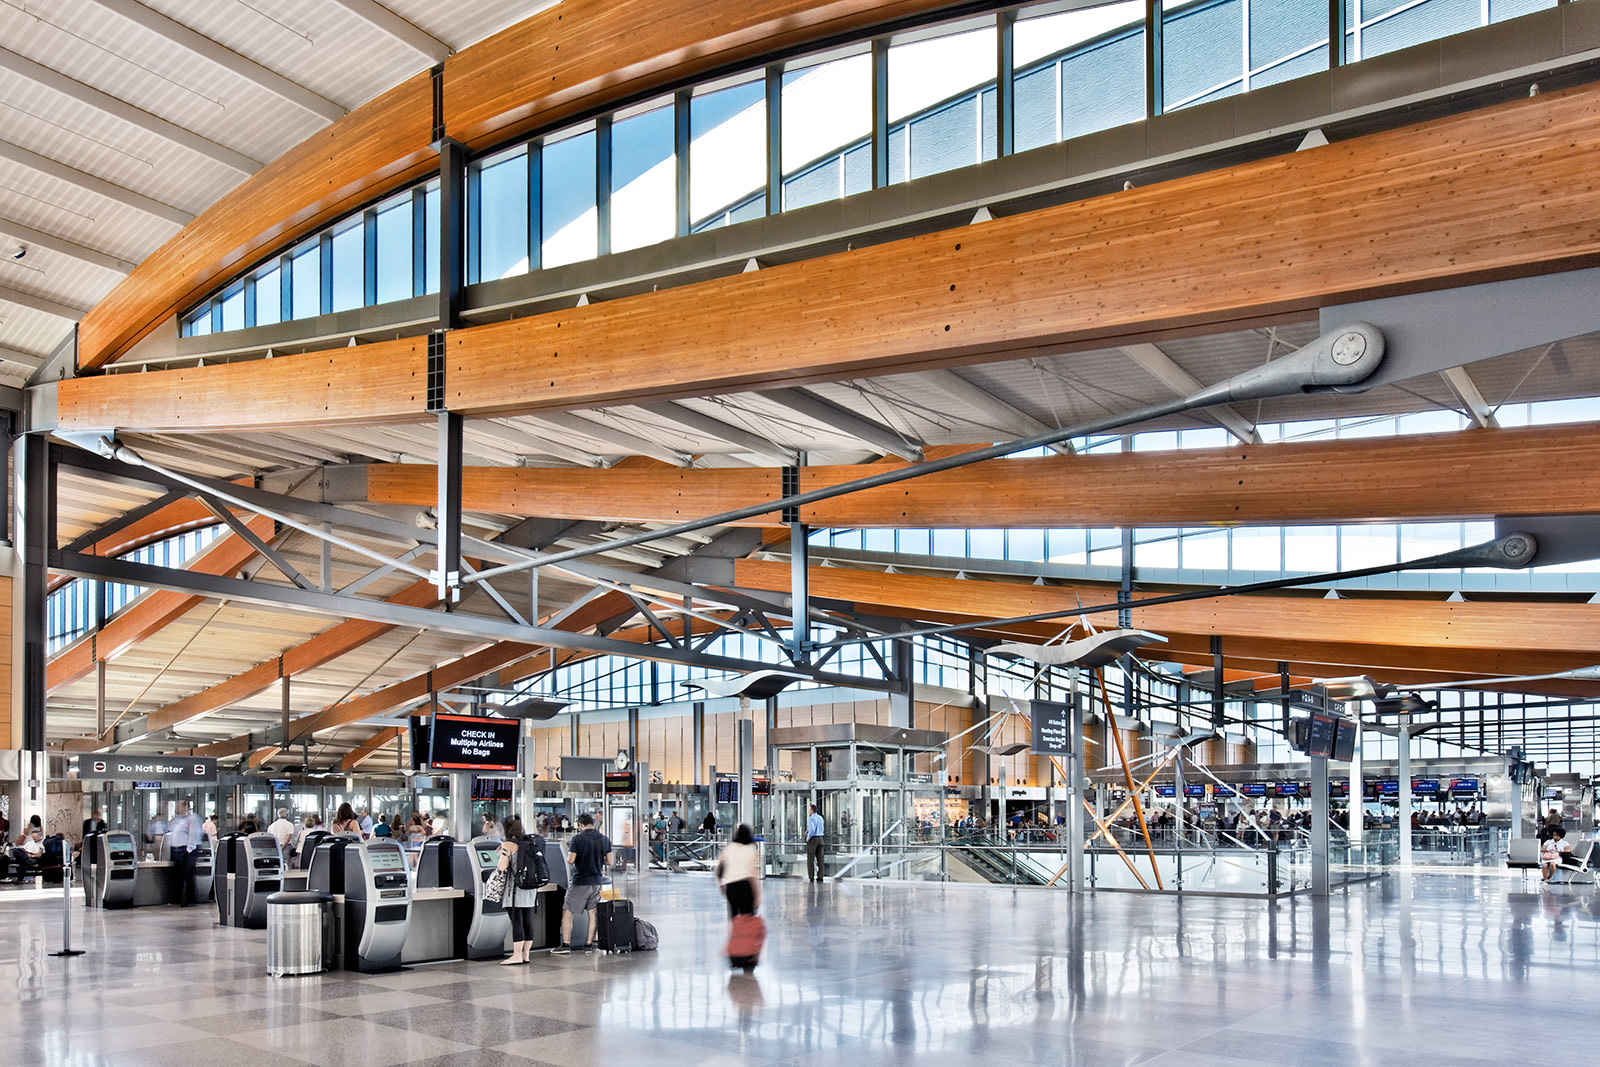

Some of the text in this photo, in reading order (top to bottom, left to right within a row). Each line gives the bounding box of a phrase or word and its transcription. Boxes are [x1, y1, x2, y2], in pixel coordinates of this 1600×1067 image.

[461, 730, 495, 739] CHECK IN
[450, 738, 504, 748] Multiple Airlines
[462, 747, 490, 758] No Bags
[117, 764, 184, 774] Do Not Enter
